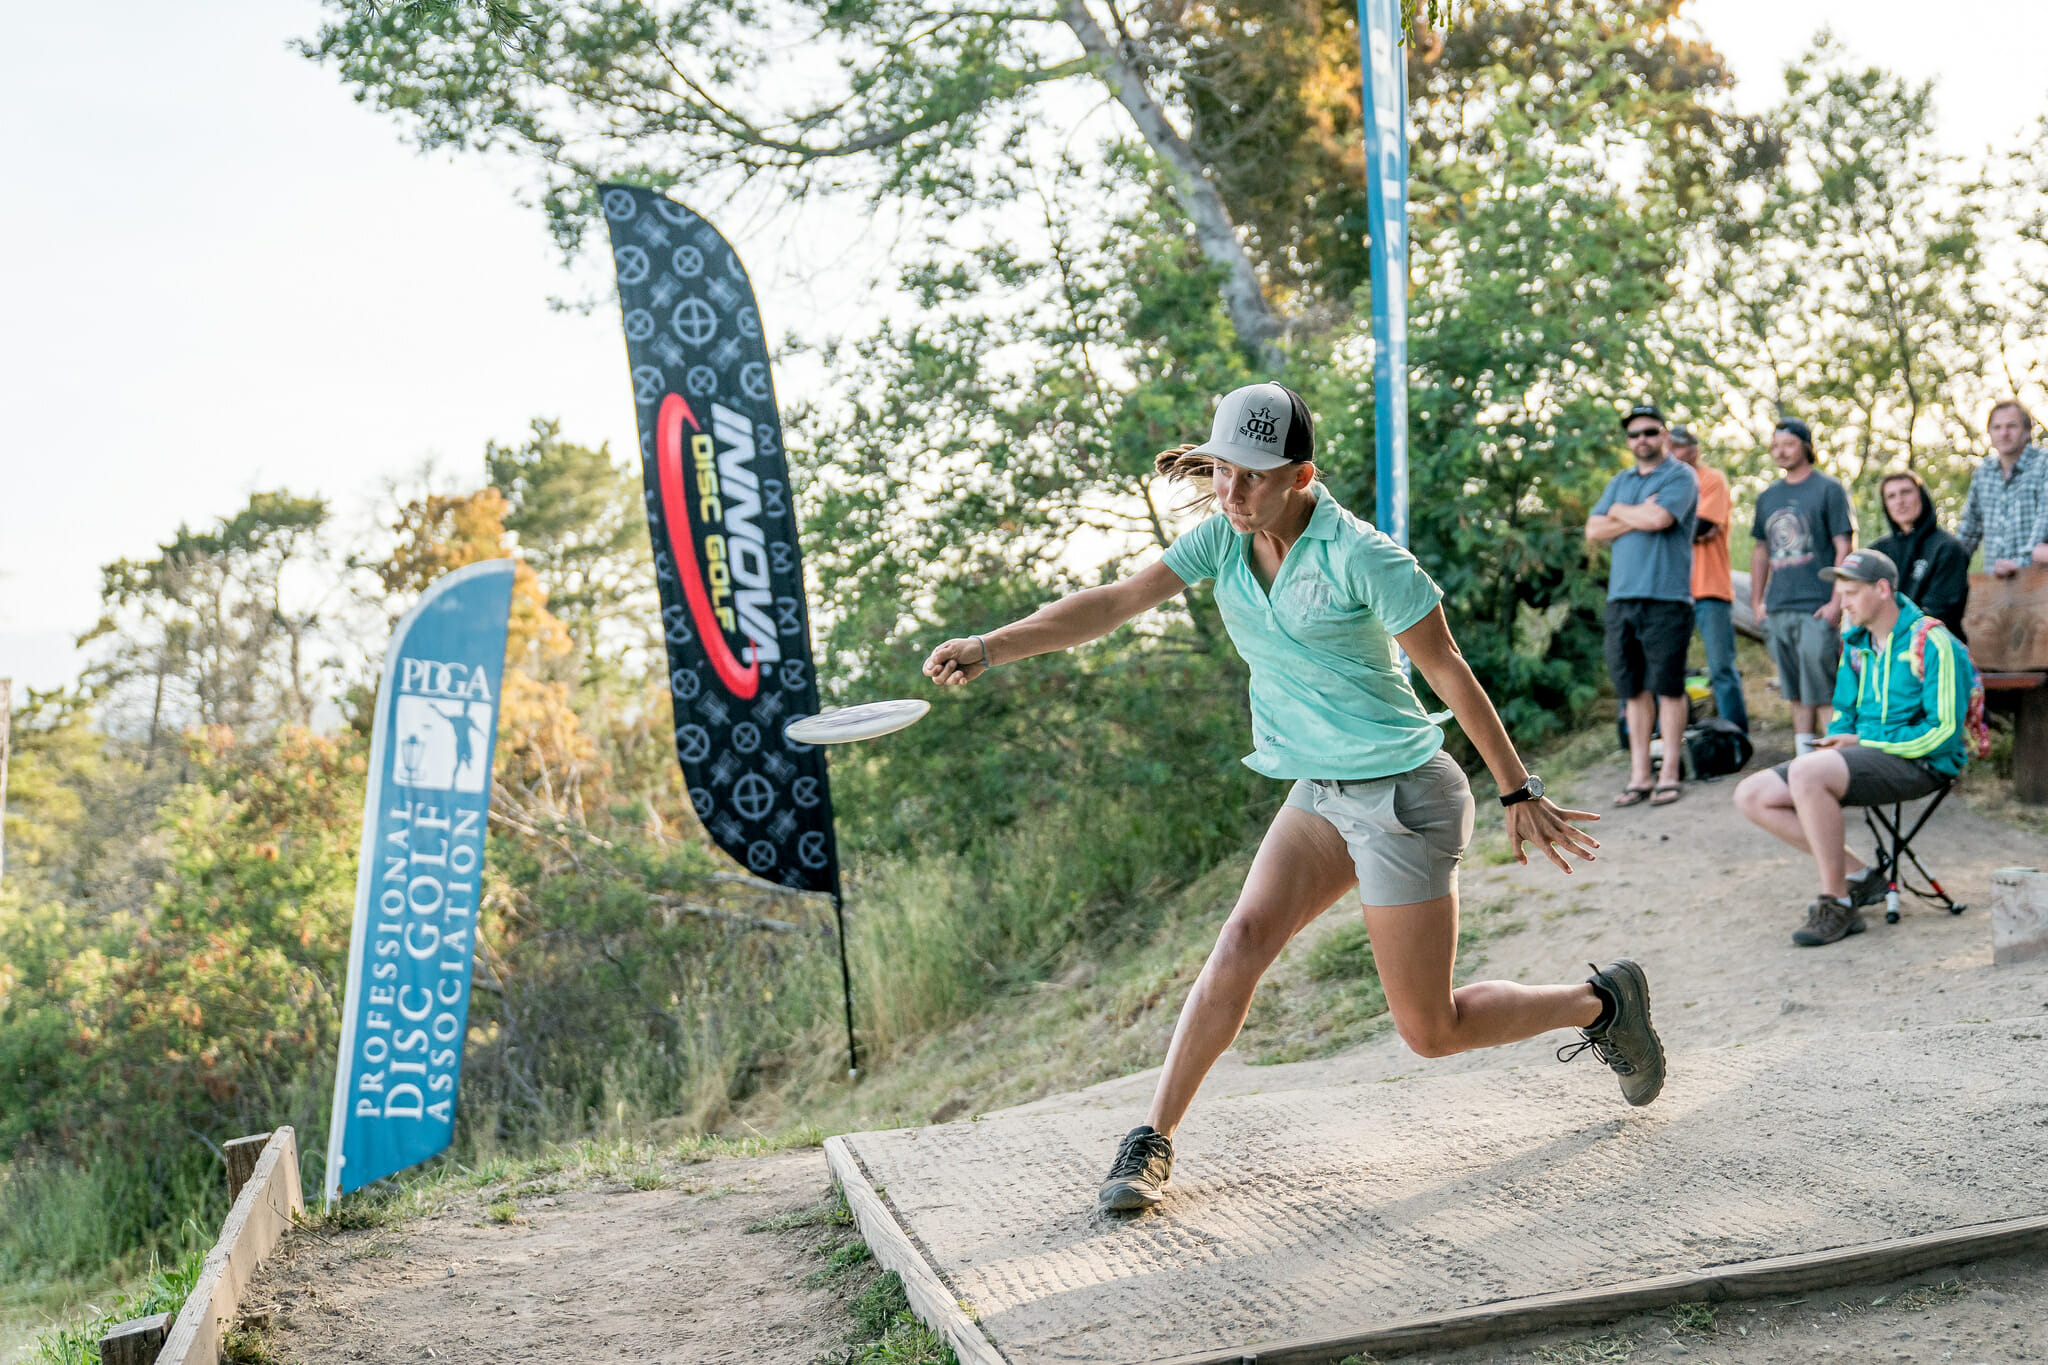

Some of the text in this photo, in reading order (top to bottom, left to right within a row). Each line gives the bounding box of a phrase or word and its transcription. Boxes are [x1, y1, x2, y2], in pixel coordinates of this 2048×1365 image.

[691, 434, 736, 634] DISC GOLF
[710, 402, 781, 663] INNOVA
[400, 657, 492, 701] PDGA
[356, 801, 413, 1118] PROFESSIONAL
[384, 802, 451, 1122] DISC GOLF
[426, 808, 481, 1124] ASSOCIATION
